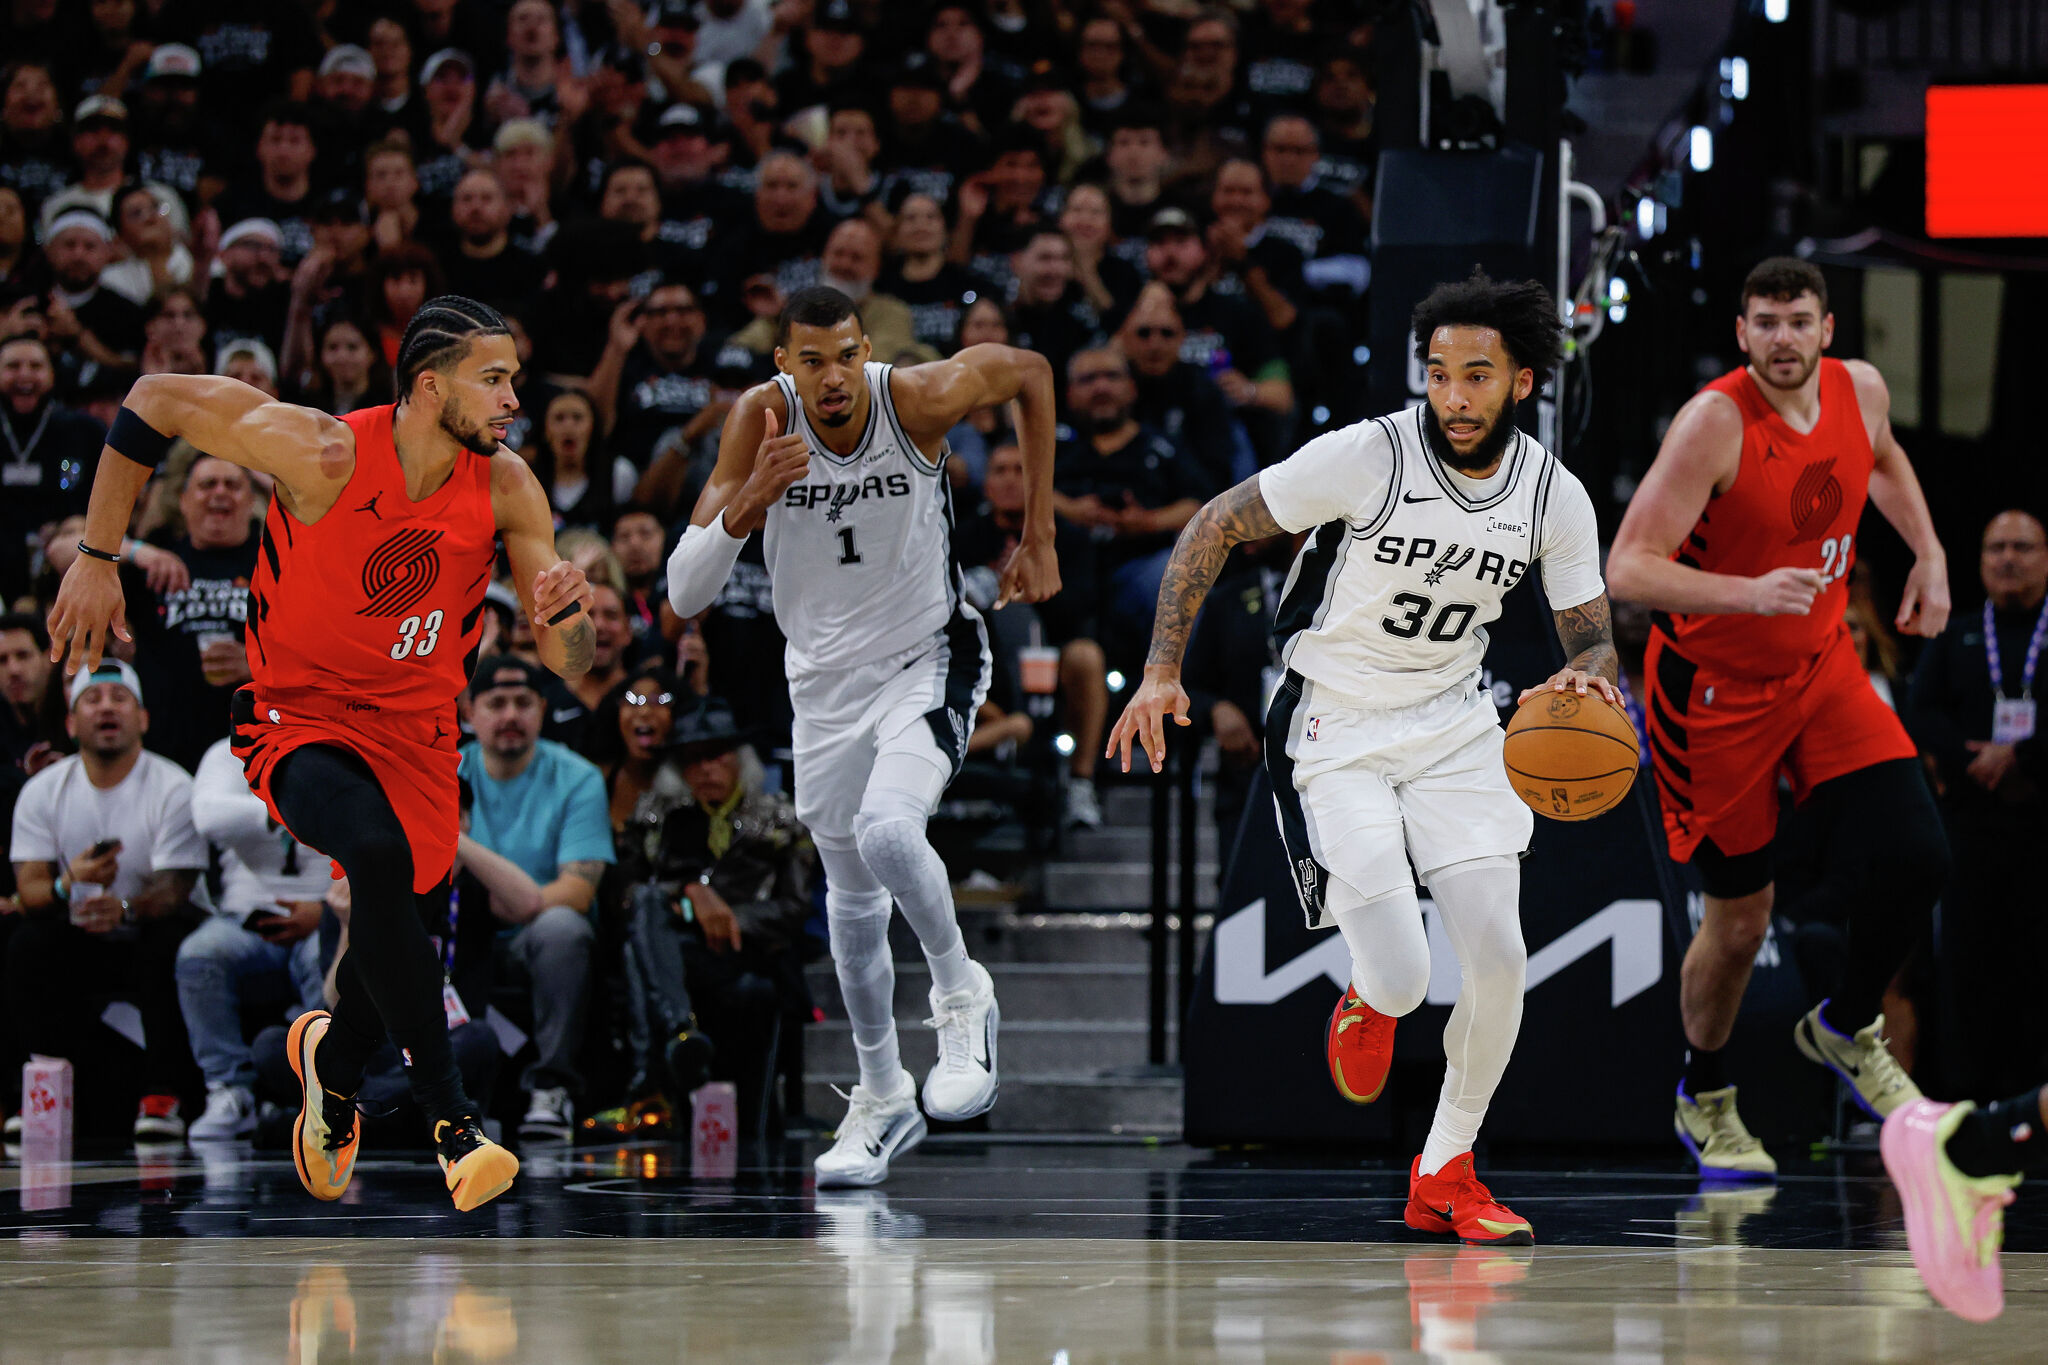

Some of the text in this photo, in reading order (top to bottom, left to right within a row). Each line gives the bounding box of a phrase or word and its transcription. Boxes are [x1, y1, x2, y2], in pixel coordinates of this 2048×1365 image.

[785, 473, 910, 523] SPURS
[837, 526, 863, 565] 1
[1492, 521, 1523, 533] LEDGER
[1373, 535, 1528, 588] SPURS
[390, 609, 444, 660] 33
[1379, 590, 1480, 643] 30
